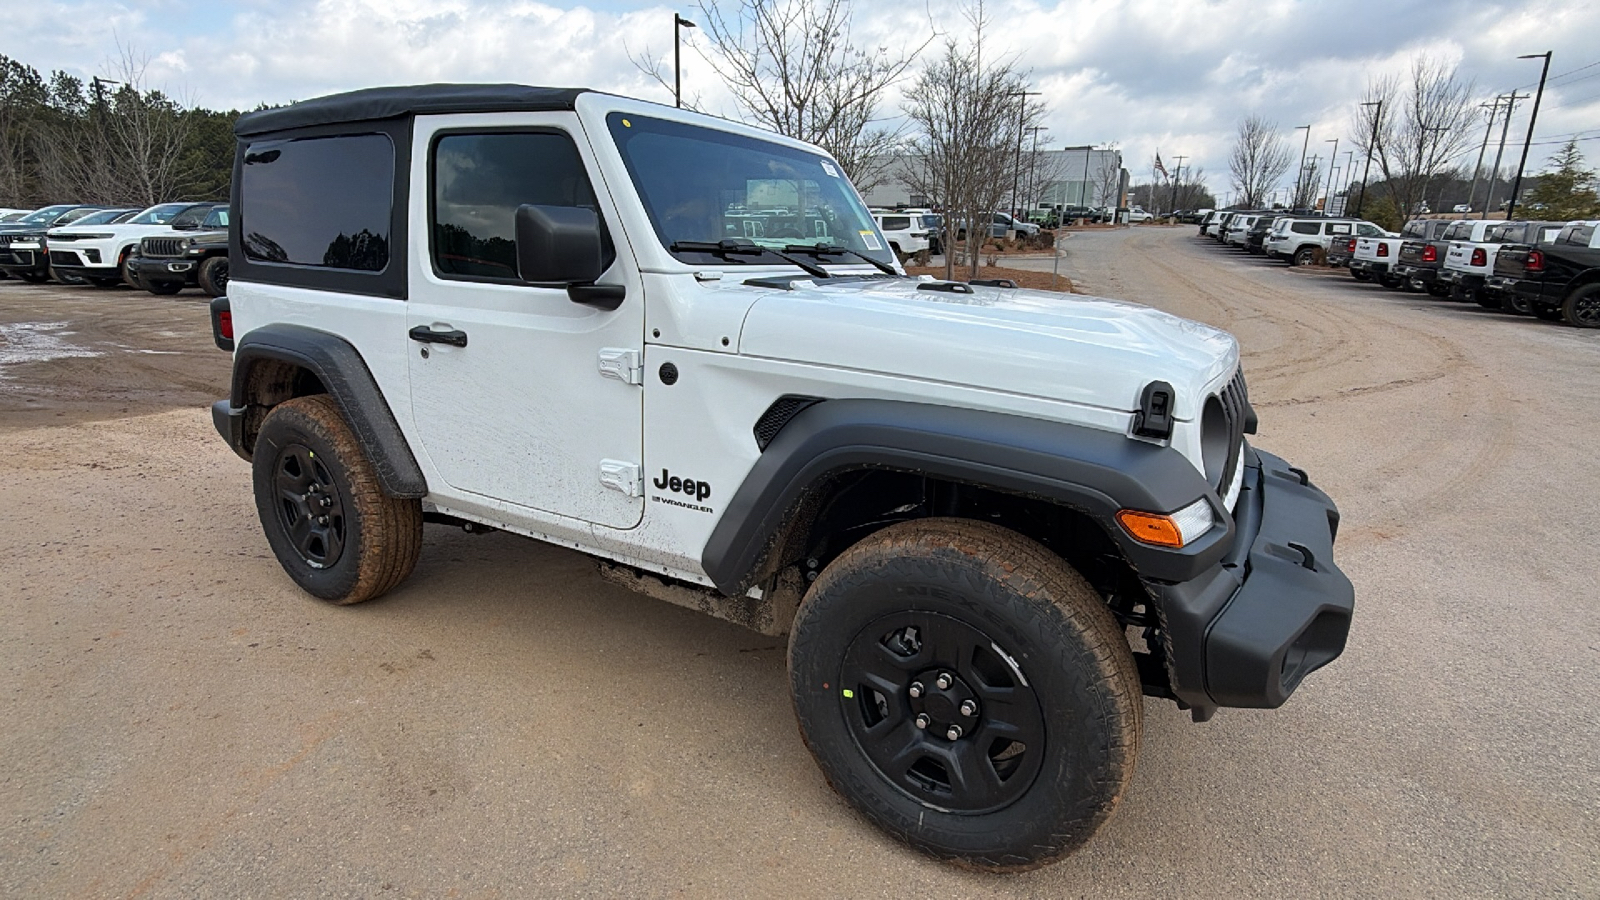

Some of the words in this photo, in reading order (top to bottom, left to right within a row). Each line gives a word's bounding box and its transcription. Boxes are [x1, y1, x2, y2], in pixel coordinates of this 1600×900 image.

[653, 468, 711, 502] Jeep
[661, 497, 713, 514] WRANGLER
[905, 585, 1028, 647] NEXEN
